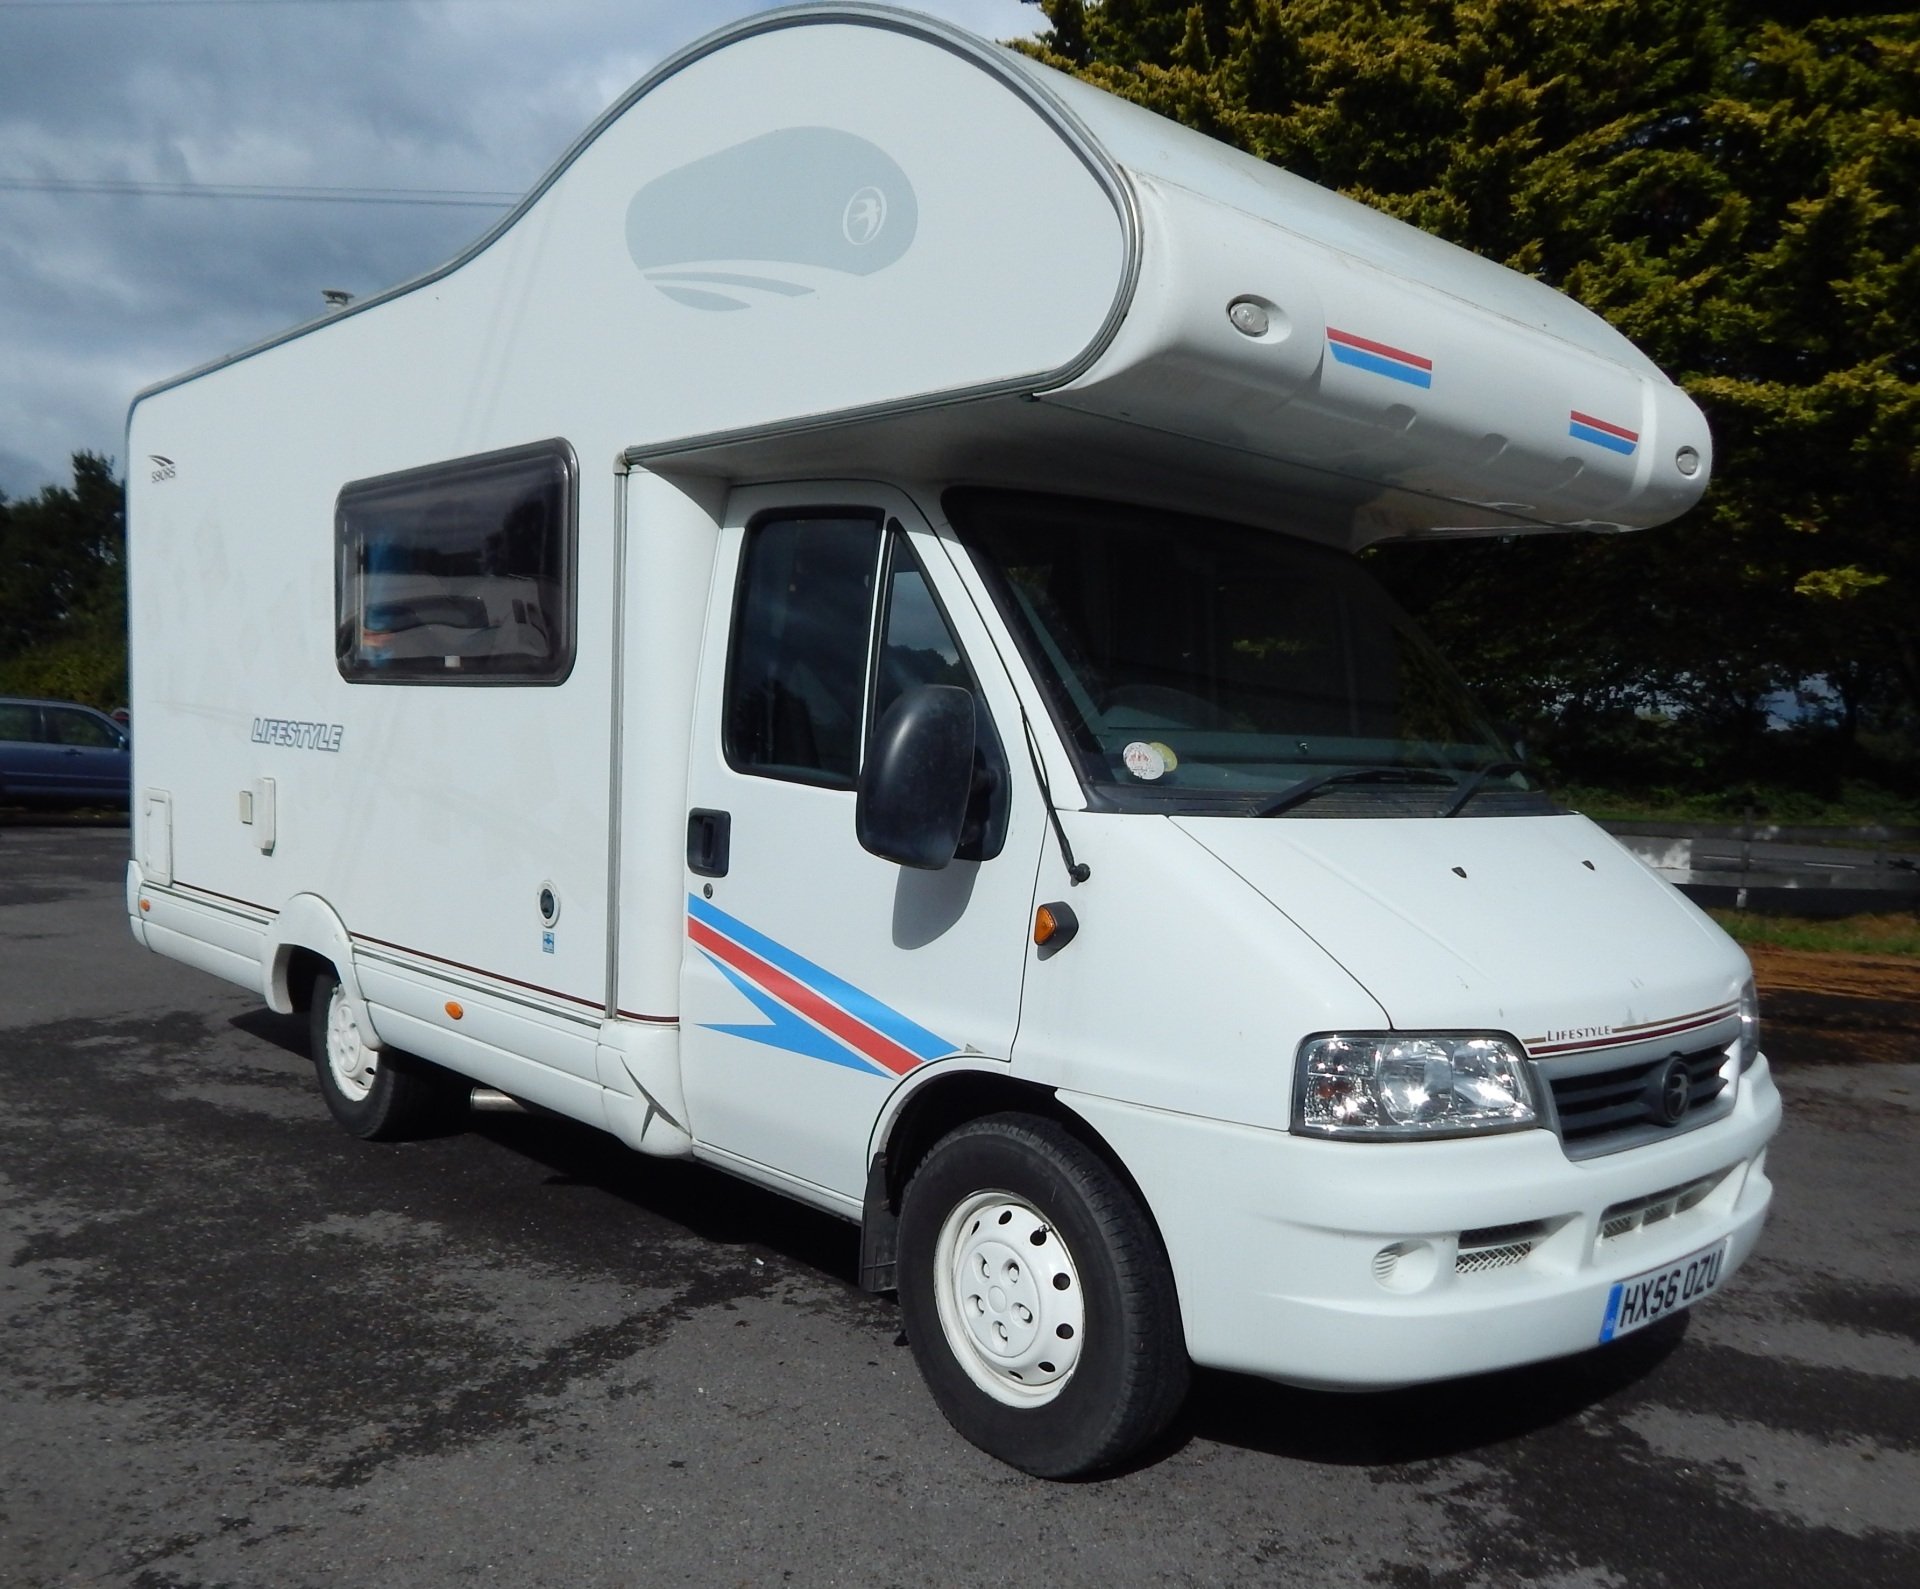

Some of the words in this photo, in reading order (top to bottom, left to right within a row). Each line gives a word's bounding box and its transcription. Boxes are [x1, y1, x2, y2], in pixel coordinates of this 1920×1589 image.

[252, 718, 343, 752] LIFESTYLE
[1547, 1025, 1611, 1041] LIFESTYLE
[1620, 1269, 1681, 1328] HX56
[1682, 1249, 1723, 1300] OZU
